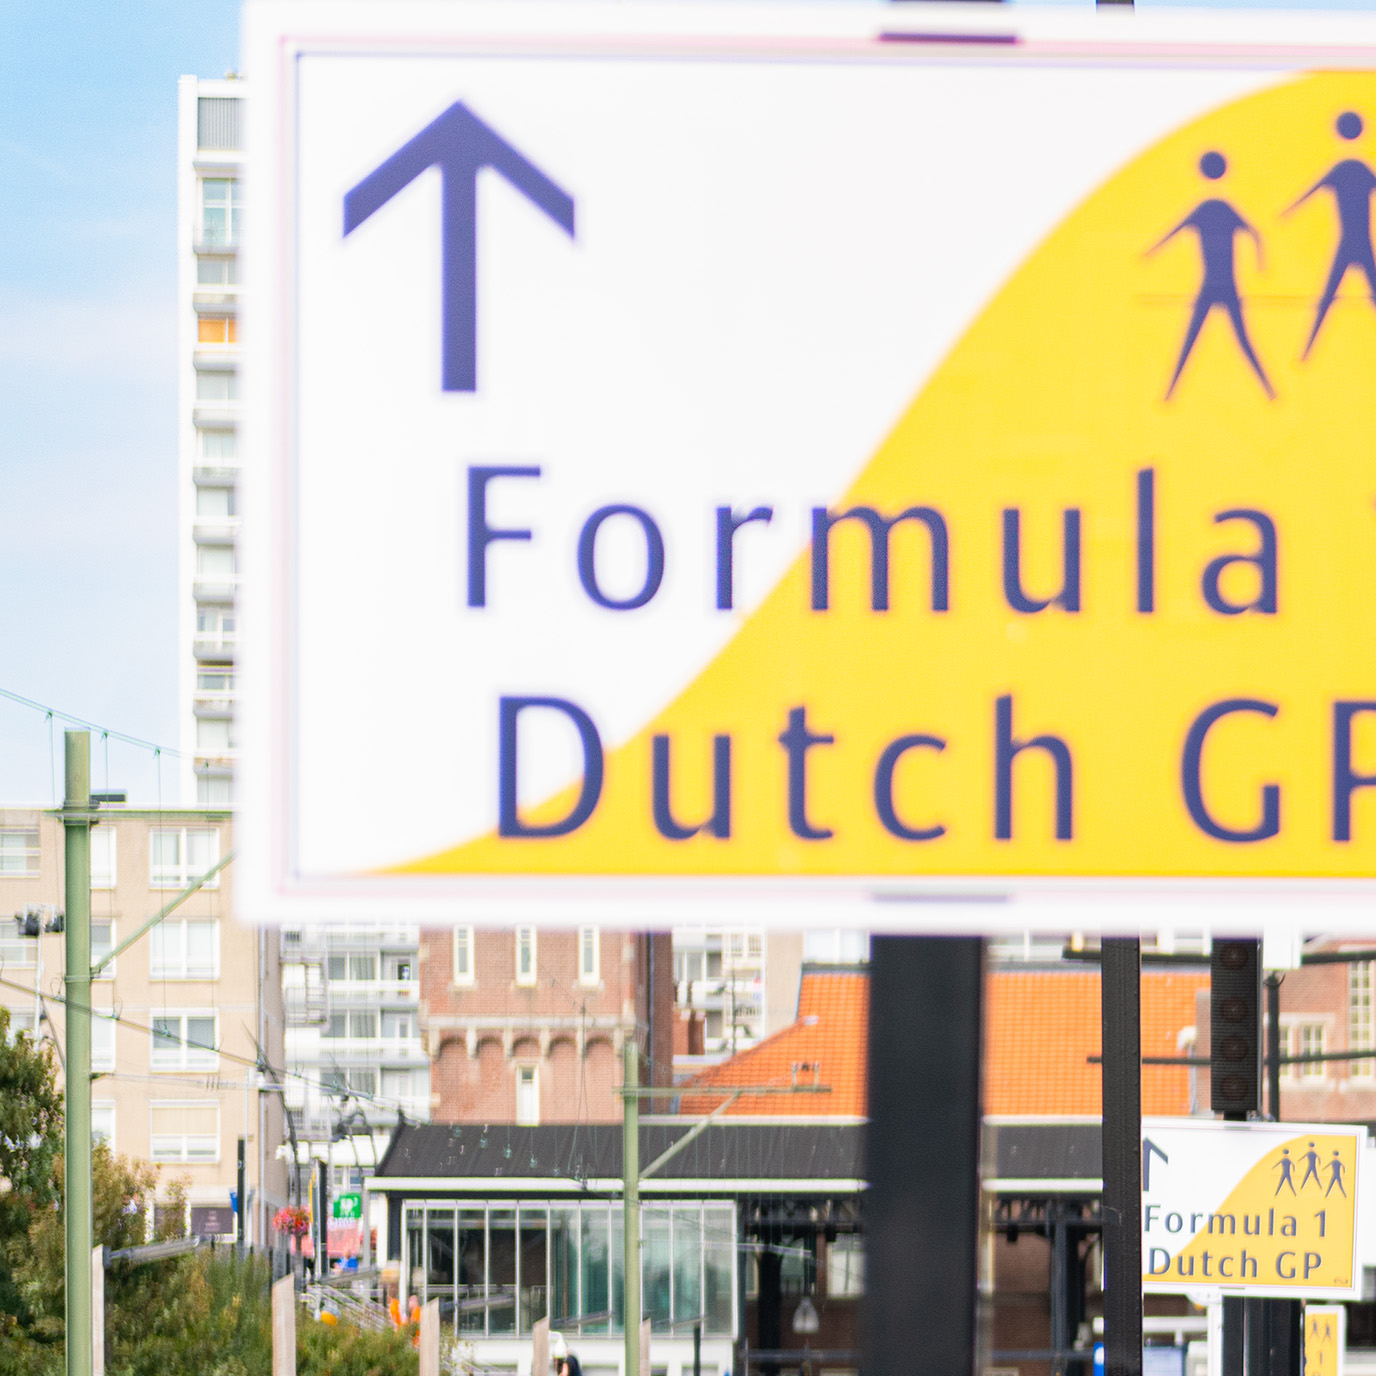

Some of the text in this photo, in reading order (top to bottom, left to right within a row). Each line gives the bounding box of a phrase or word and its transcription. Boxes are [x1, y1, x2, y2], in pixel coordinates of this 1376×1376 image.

[465, 464, 1280, 618] Formula
[496, 693, 1076, 843] Dutch
[1144, 1205, 1327, 1238] Formula 1
[1148, 1248, 1323, 1280] Dutch GP
